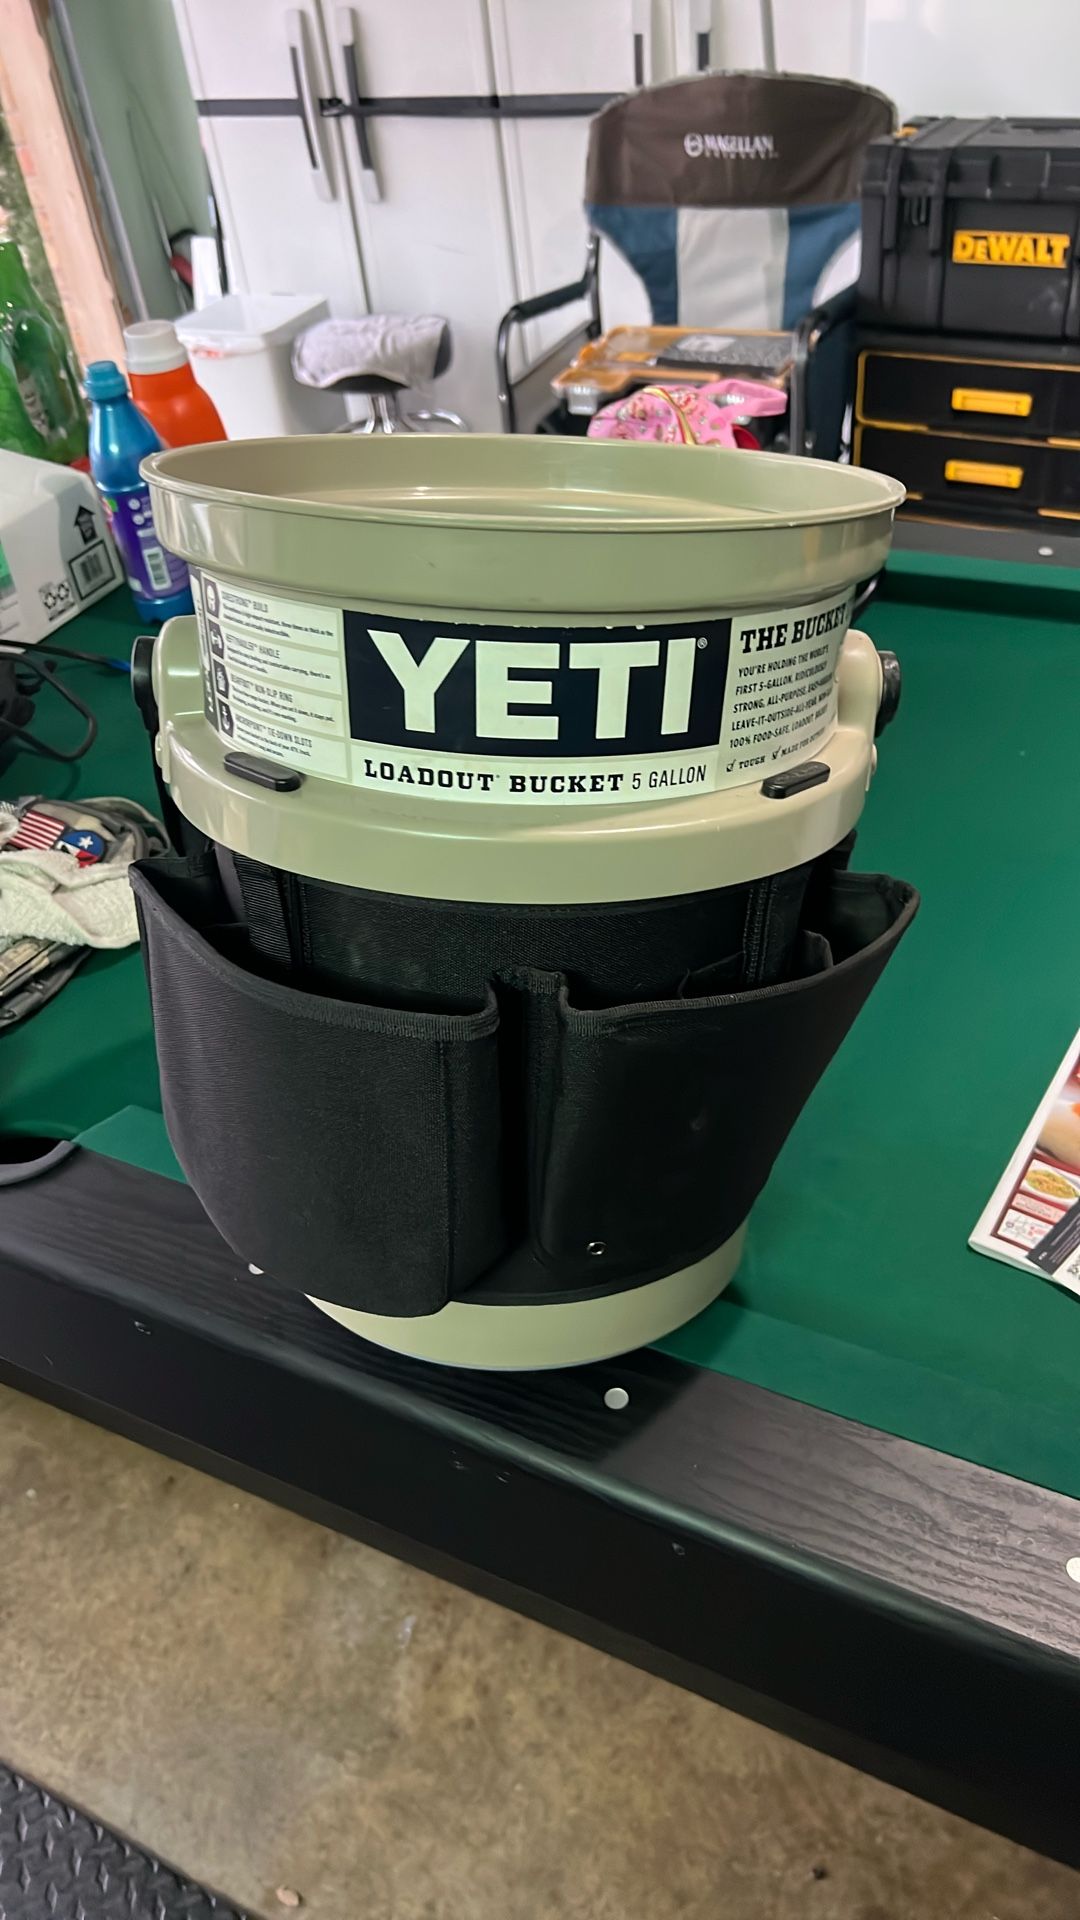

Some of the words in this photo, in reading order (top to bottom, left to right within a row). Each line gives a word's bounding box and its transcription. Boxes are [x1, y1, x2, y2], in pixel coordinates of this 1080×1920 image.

[740, 623, 789, 654] THE
[791, 602, 846, 644] BUCKET
[738, 663, 766, 678] YOU'RE
[767, 656, 797, 672] HOLDING
[735, 682, 758, 696] FIRST
[733, 698, 766, 713] STRONG,
[729, 737, 751, 748] 100%
[738, 755, 766, 769] TOUGH
[364, 759, 495, 791] LOADOUT
[509, 773, 624, 793] BUCKET
[631, 772, 642, 790] 5
[648, 765, 707, 788] GALLON
